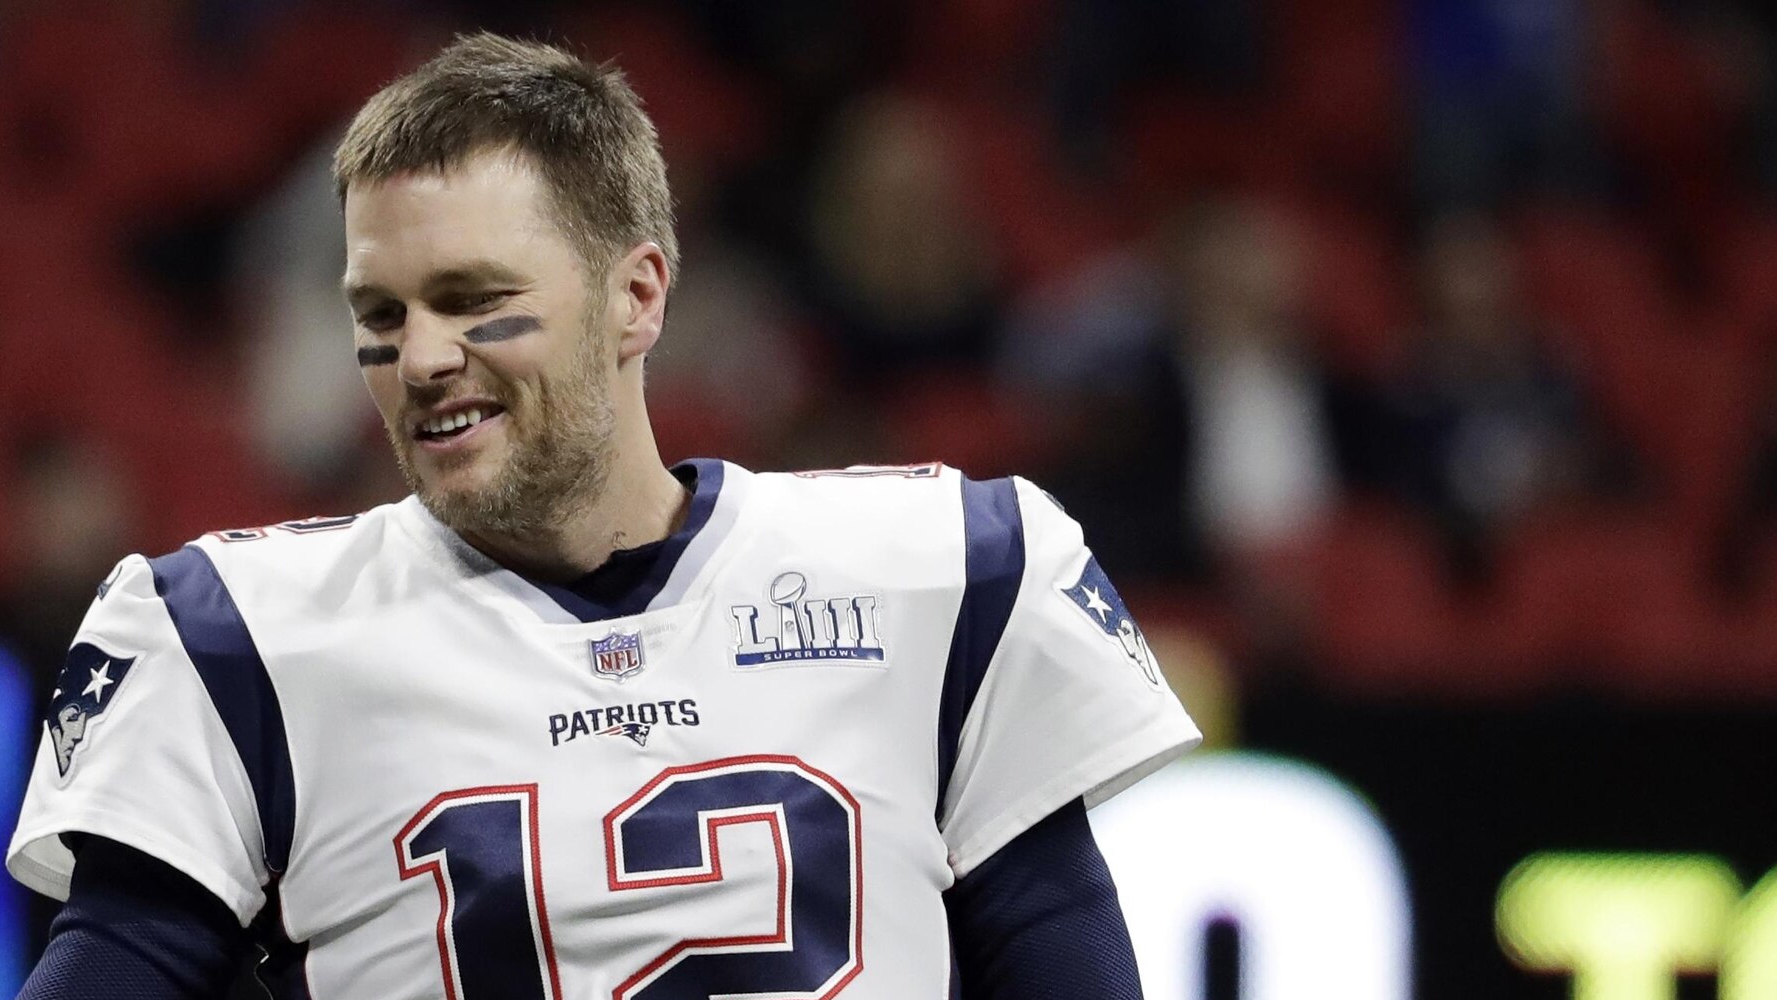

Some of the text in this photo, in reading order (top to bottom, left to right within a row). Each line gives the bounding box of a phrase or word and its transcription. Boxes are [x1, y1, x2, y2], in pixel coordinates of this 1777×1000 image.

[599, 650, 638, 673] NFL
[763, 649, 858, 661] SUPER BOWL
[549, 698, 700, 747] PATRIOTS
